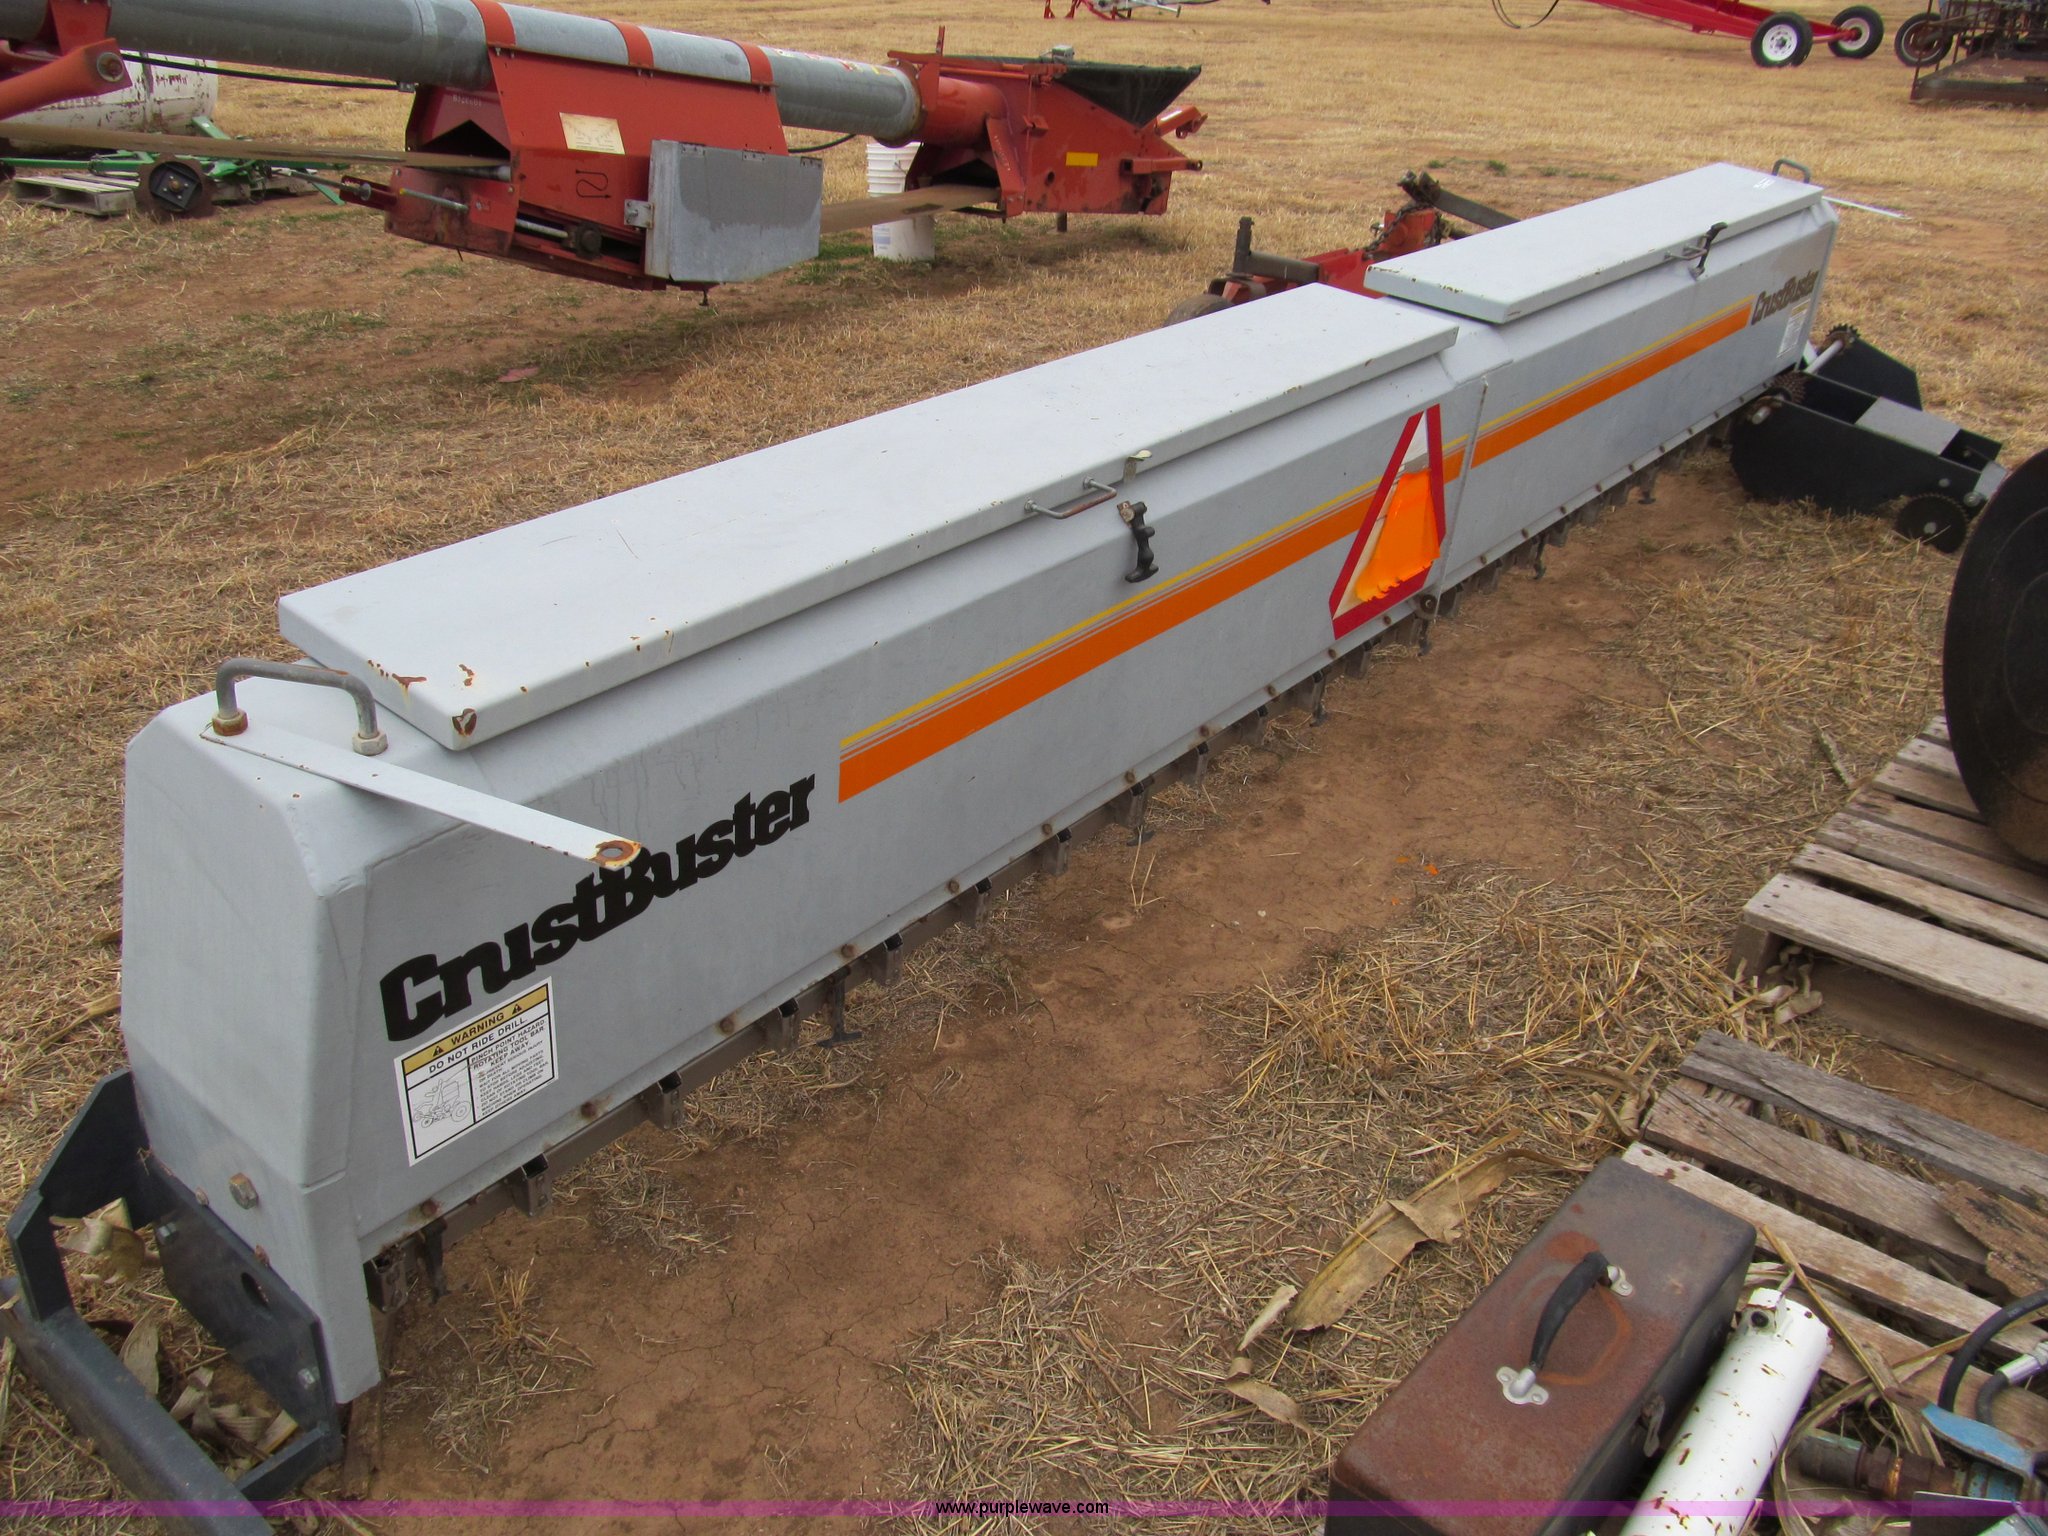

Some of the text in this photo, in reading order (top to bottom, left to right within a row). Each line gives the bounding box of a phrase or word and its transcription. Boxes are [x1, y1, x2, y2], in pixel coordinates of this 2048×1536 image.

[1751, 270, 1819, 325] CrustBuster
[380, 774, 815, 1041] CrustBuster
[429, 1015, 527, 1073] DO NOT RIDE DRILL.
[451, 1011, 504, 1046] WARNING
[471, 1047, 492, 1063] PINCH
[495, 1035, 515, 1050] POINT
[473, 1045, 508, 1069] ROTATING
[511, 1034, 527, 1047] TOOL
[490, 1052, 507, 1066] KEEP
